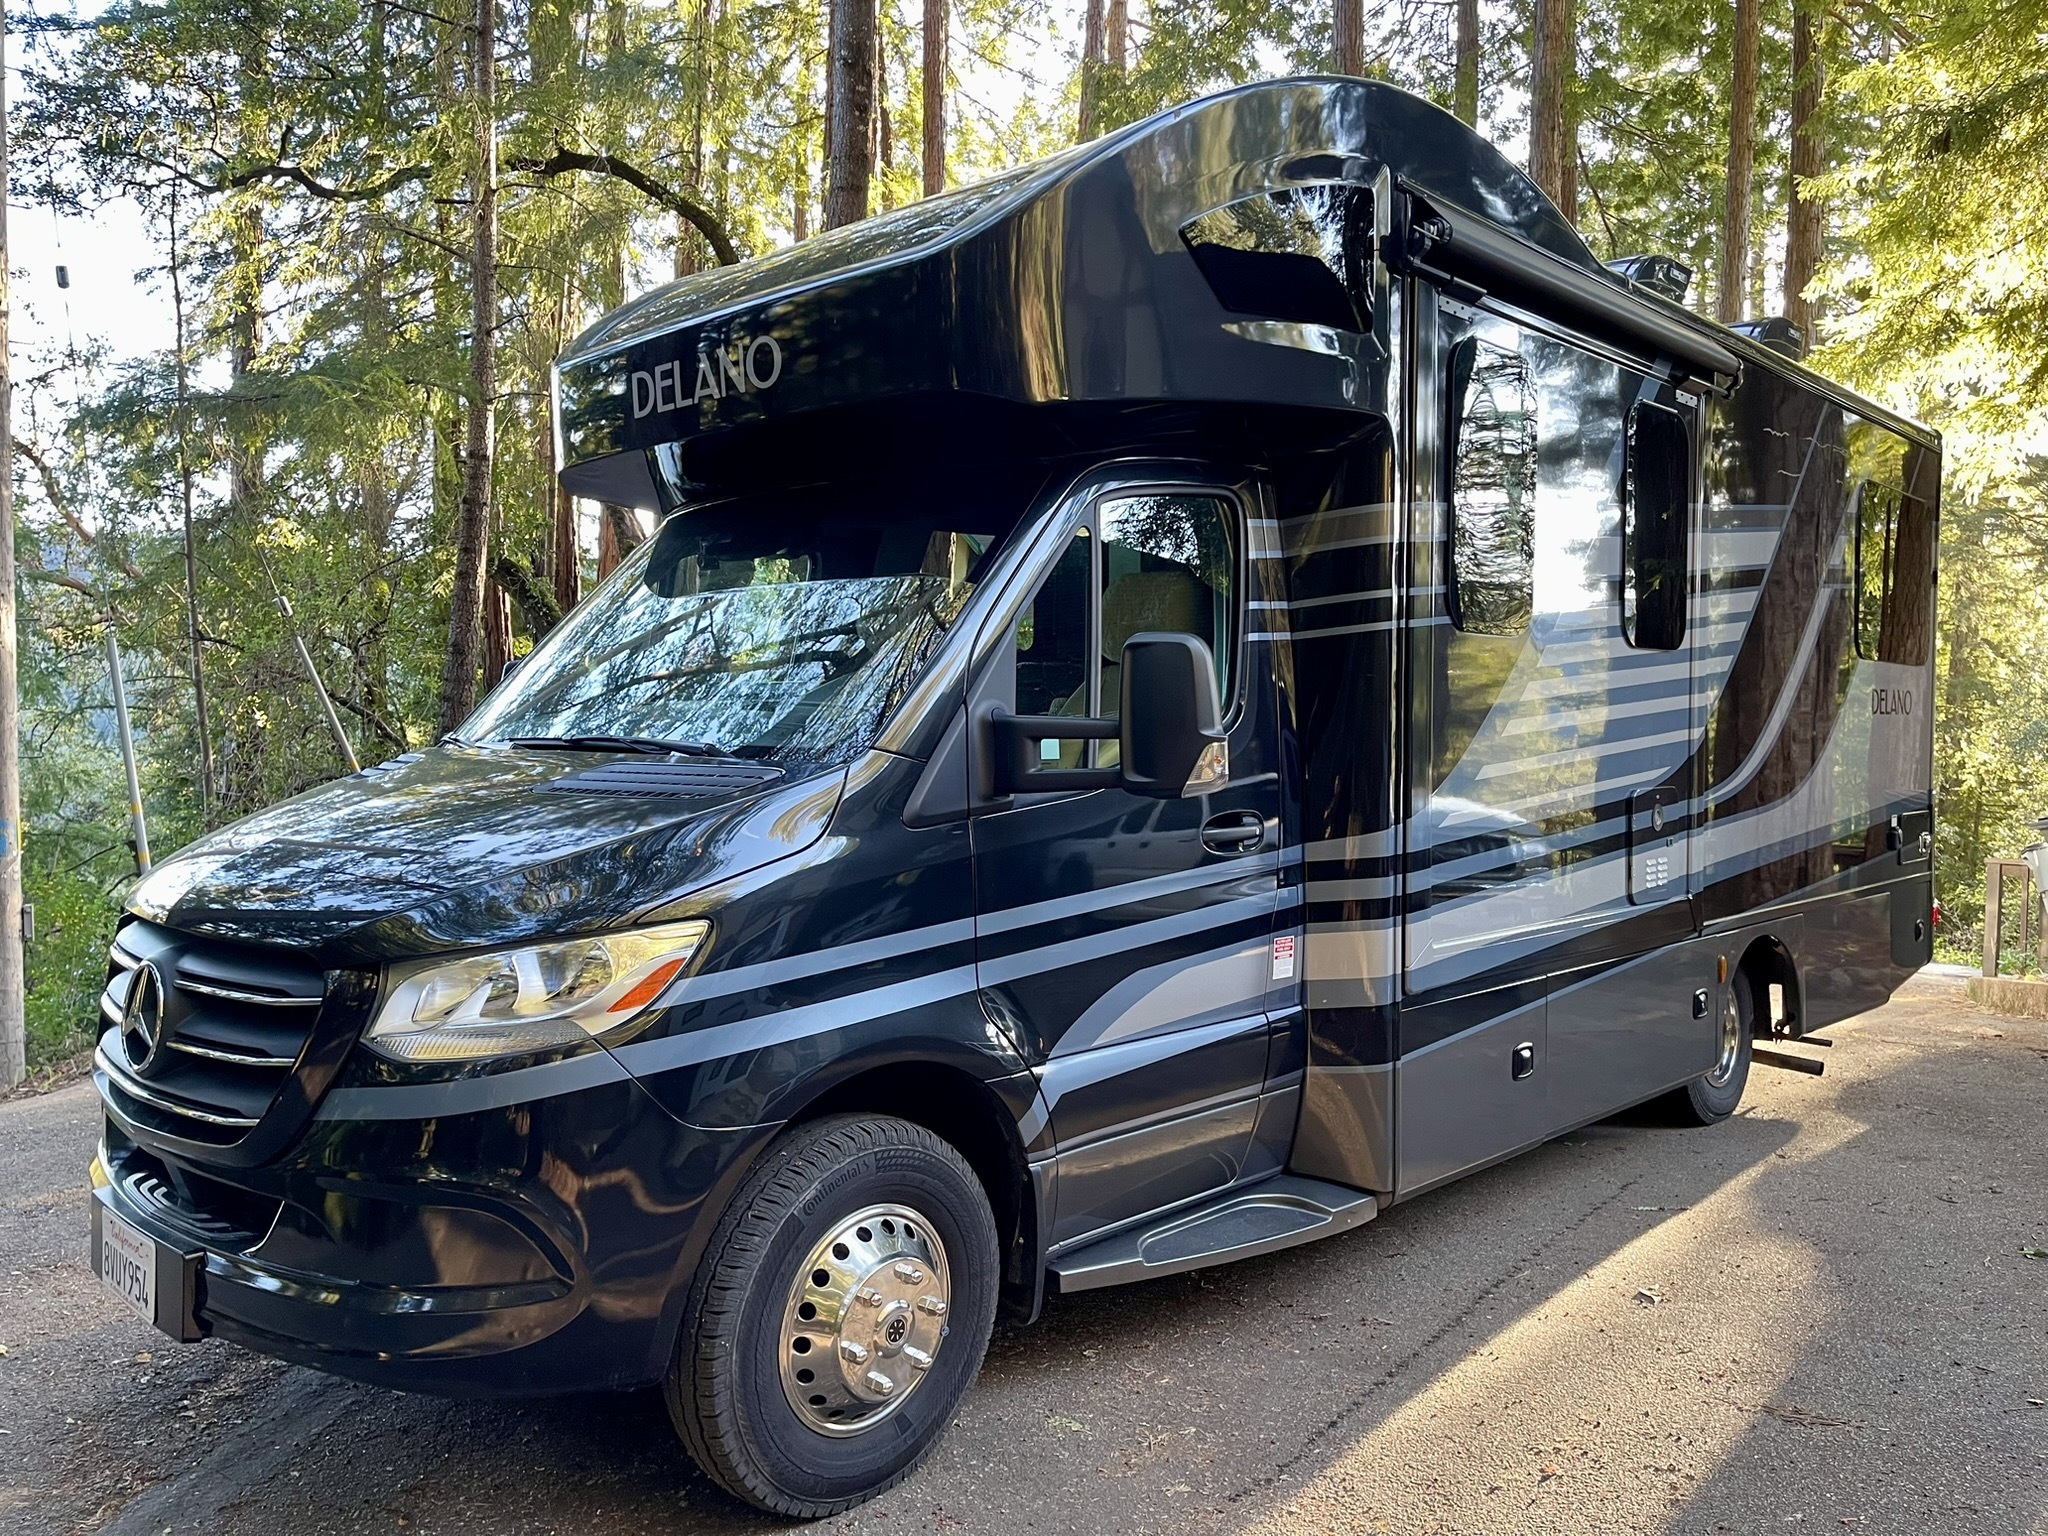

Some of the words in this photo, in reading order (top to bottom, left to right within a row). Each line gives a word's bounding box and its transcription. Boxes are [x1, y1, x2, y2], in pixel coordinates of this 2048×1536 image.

[631, 335, 782, 418] DELANO
[1872, 689, 1912, 715] DELANO
[803, 1162, 862, 1216] Continental
[111, 1225, 143, 1258] California
[103, 1241, 149, 1309] 8VUY954
